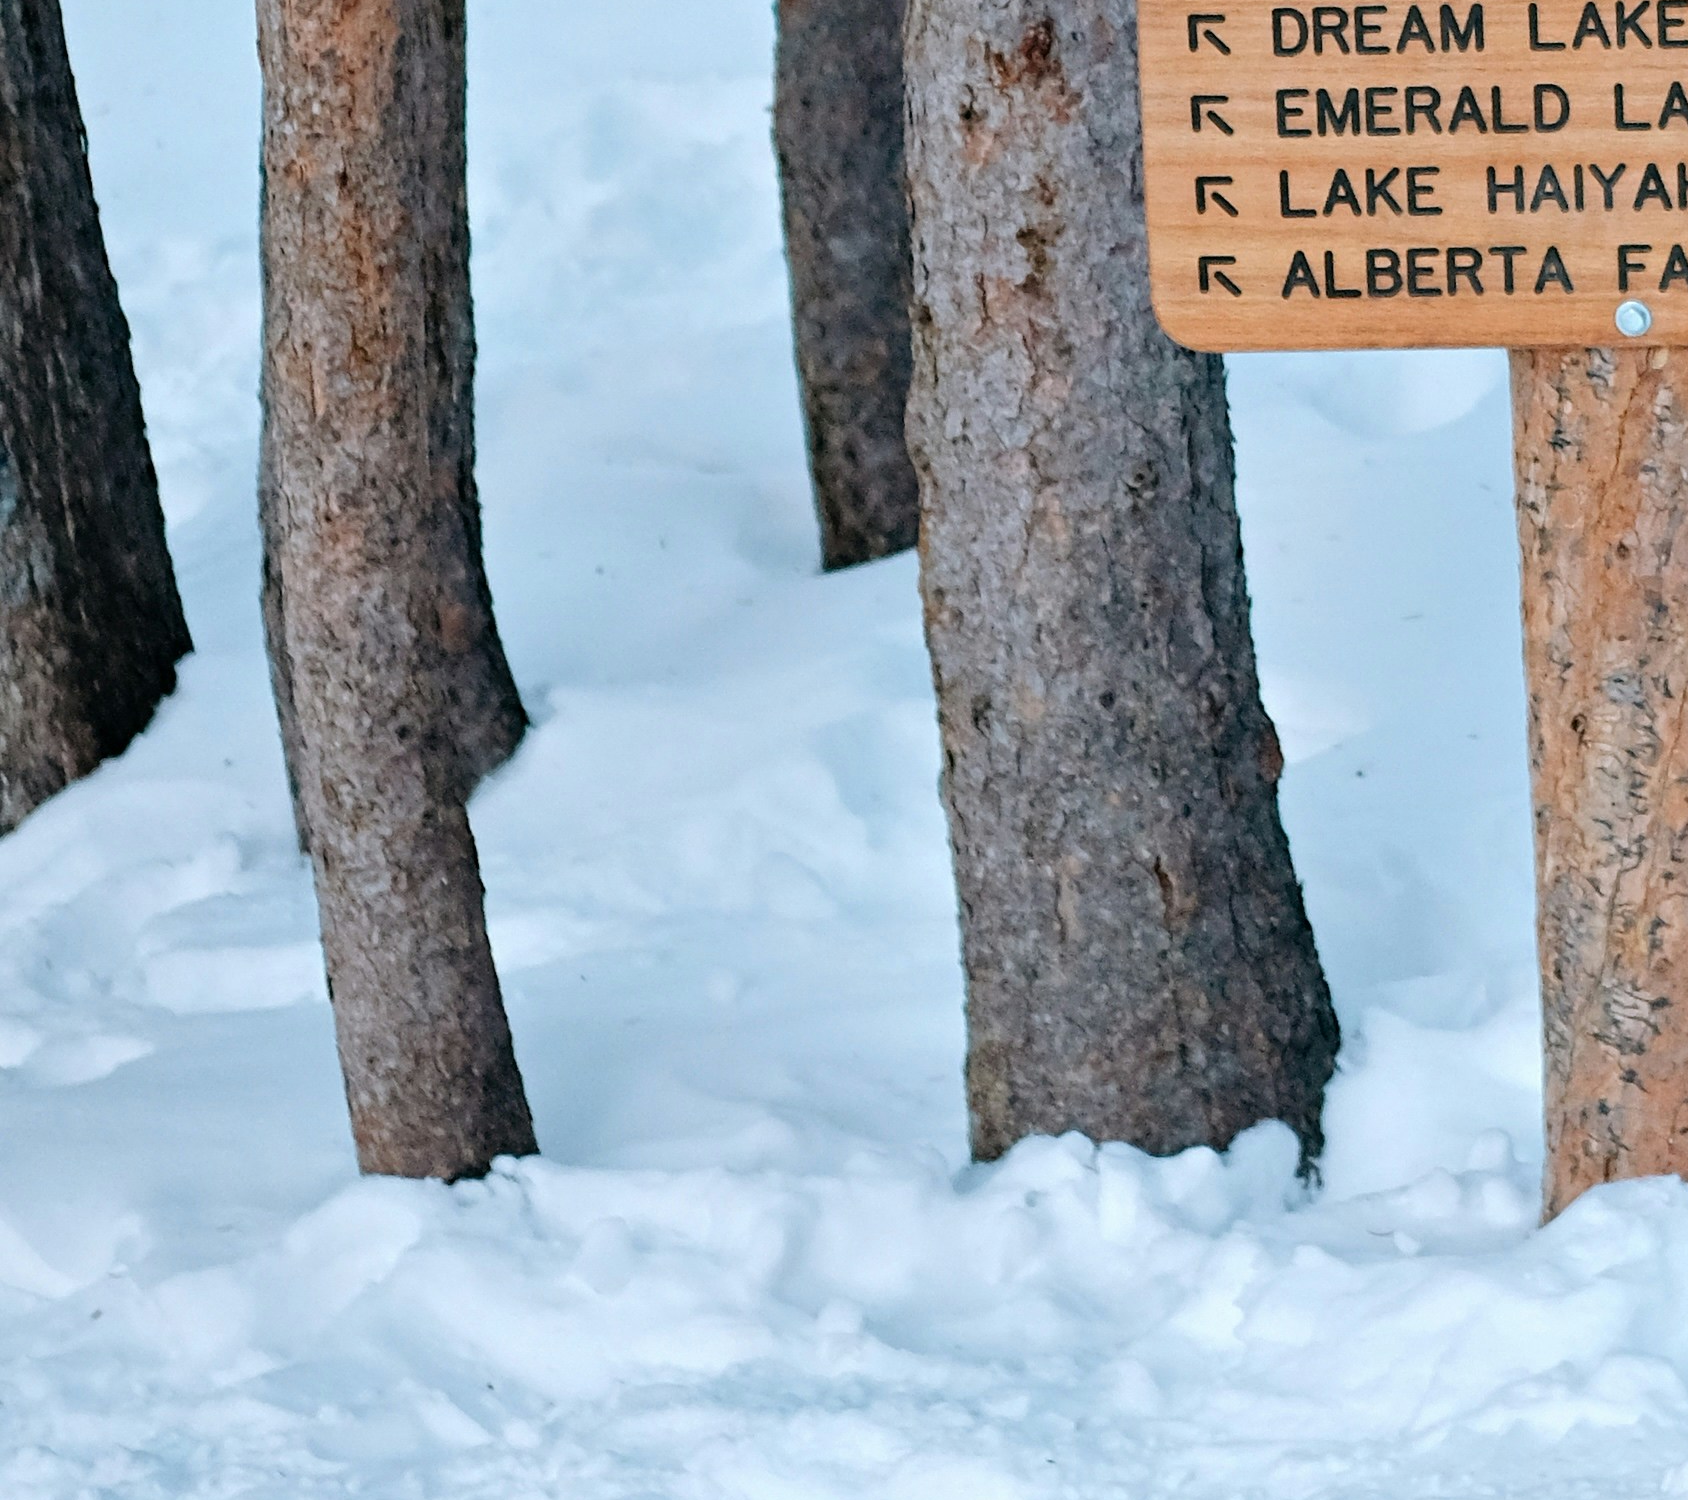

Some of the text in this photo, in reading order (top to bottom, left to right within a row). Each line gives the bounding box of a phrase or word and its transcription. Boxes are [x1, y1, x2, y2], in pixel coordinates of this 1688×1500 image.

[1271, 3, 1485, 58] DREAM
[1275, 83, 1571, 138] EMERALD
[1279, 166, 1443, 219] LAKE
[1281, 245, 1574, 299] ALBERTA
